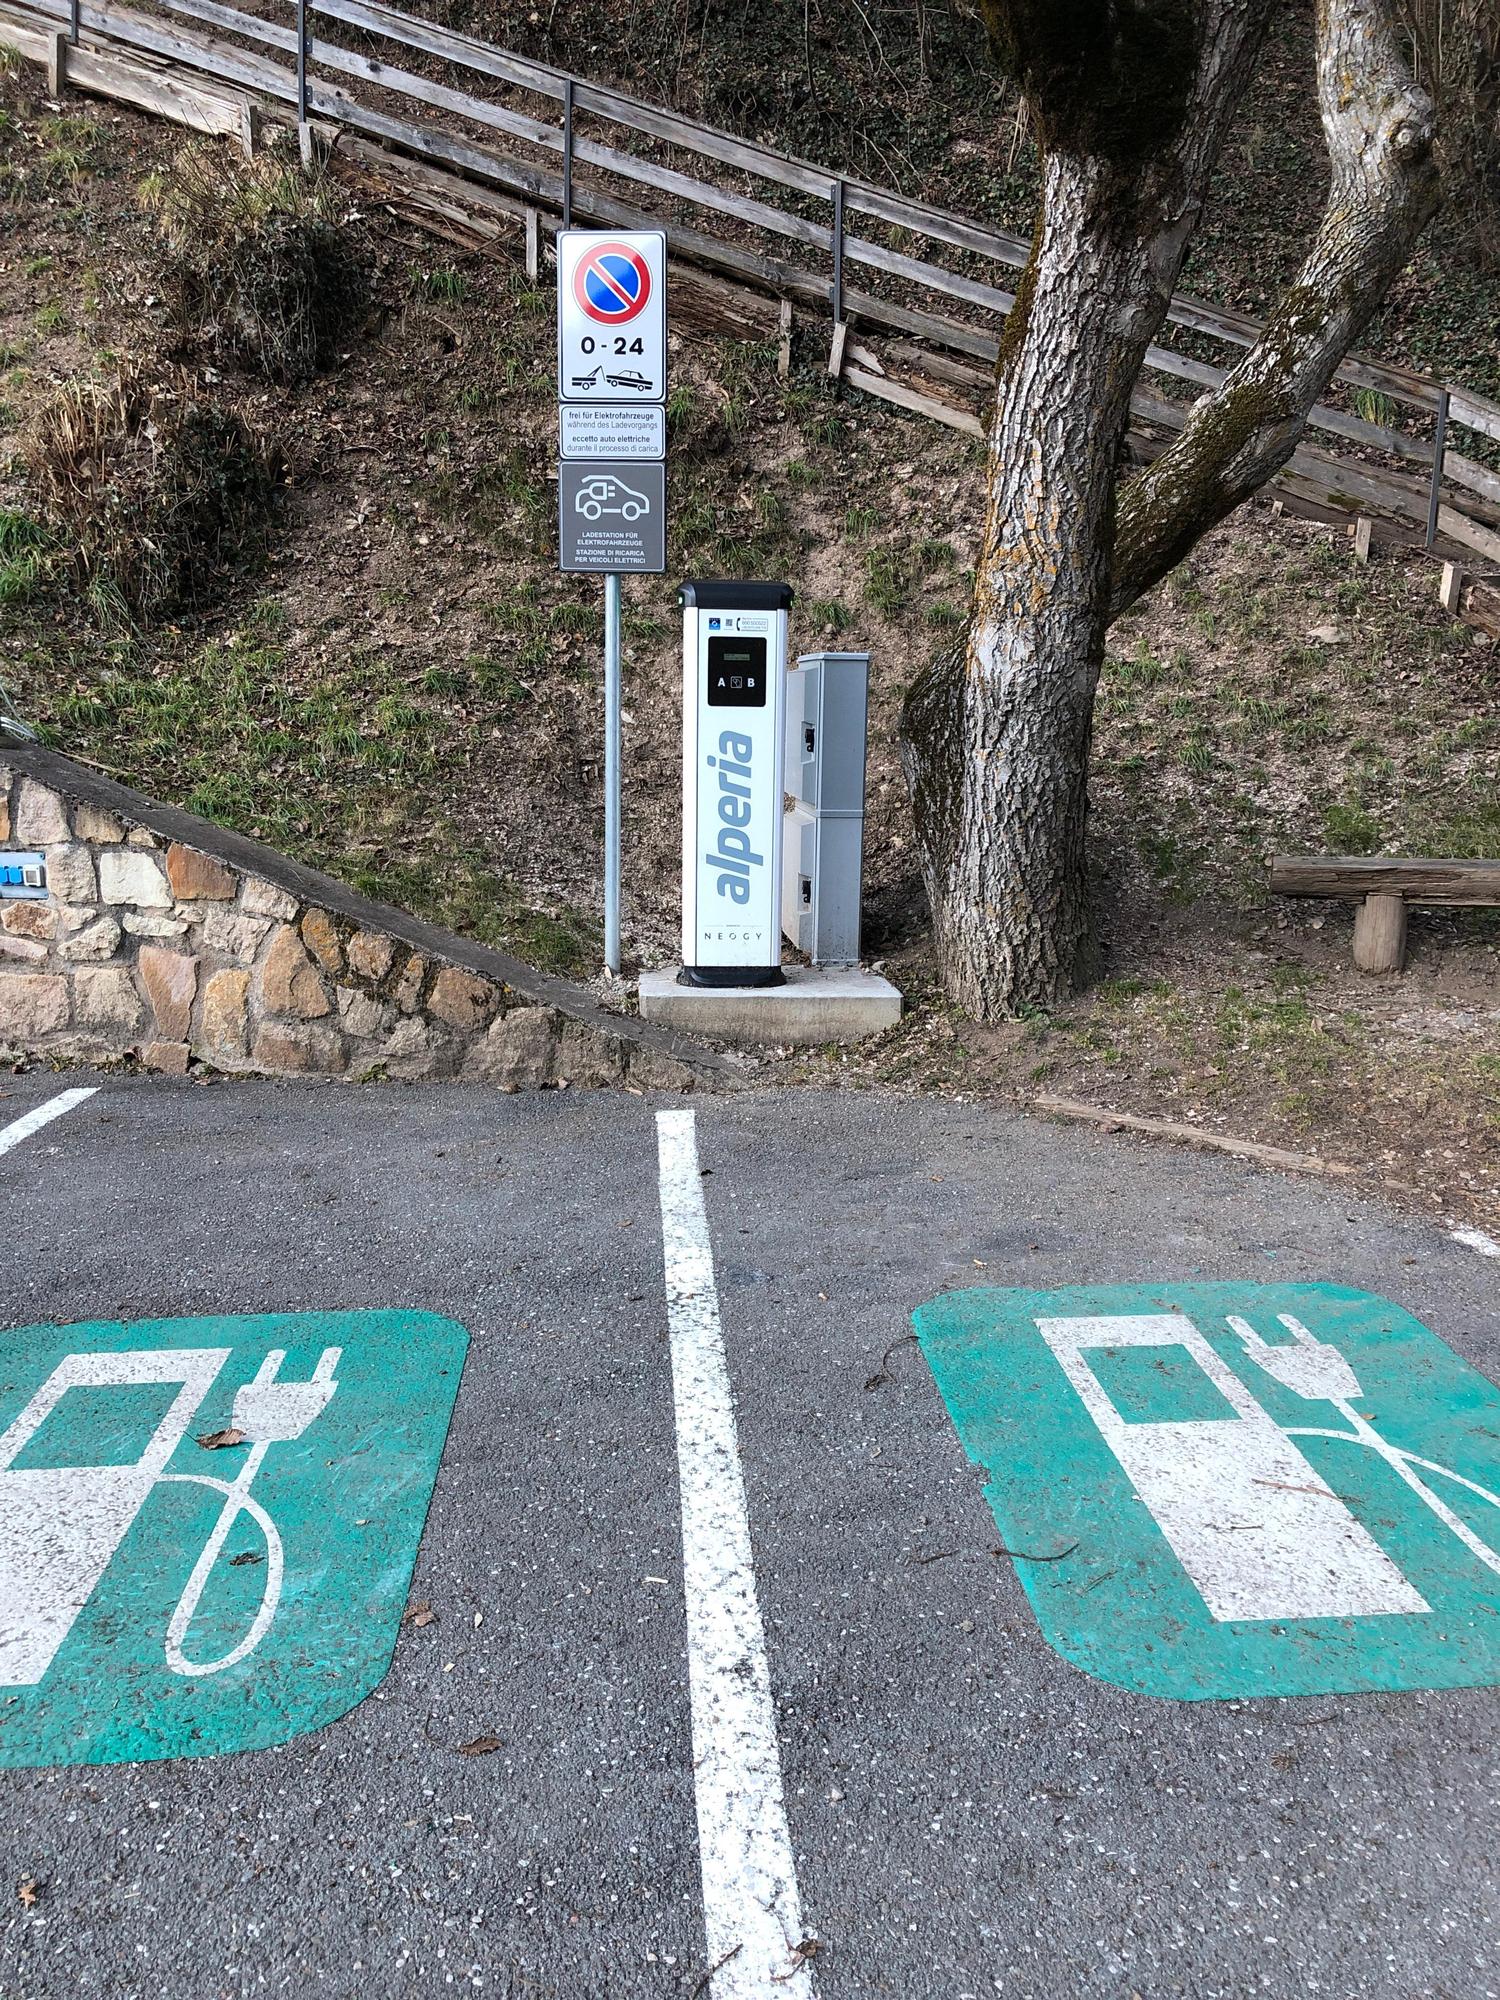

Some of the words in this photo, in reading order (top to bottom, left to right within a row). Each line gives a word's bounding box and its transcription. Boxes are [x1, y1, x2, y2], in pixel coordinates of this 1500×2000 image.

[581, 336, 595, 354] 0
[614, 337, 644, 355] 24
[569, 411, 580, 419] frei
[582, 411, 592, 420] für
[594, 412, 654, 421] Elektrofahrzeuge
[611, 421, 658, 430] Ladevorgangs
[572, 435, 598, 443] eccetto
[617, 435, 650, 443] elettriche
[567, 444, 592, 452] durante
[631, 444, 637, 452] di
[638, 445, 658, 453] carica
[717, 677, 725, 687] A
[747, 678, 755, 687] B
[706, 730, 764, 905] alperia
[704, 932, 761, 940] NEOGY
